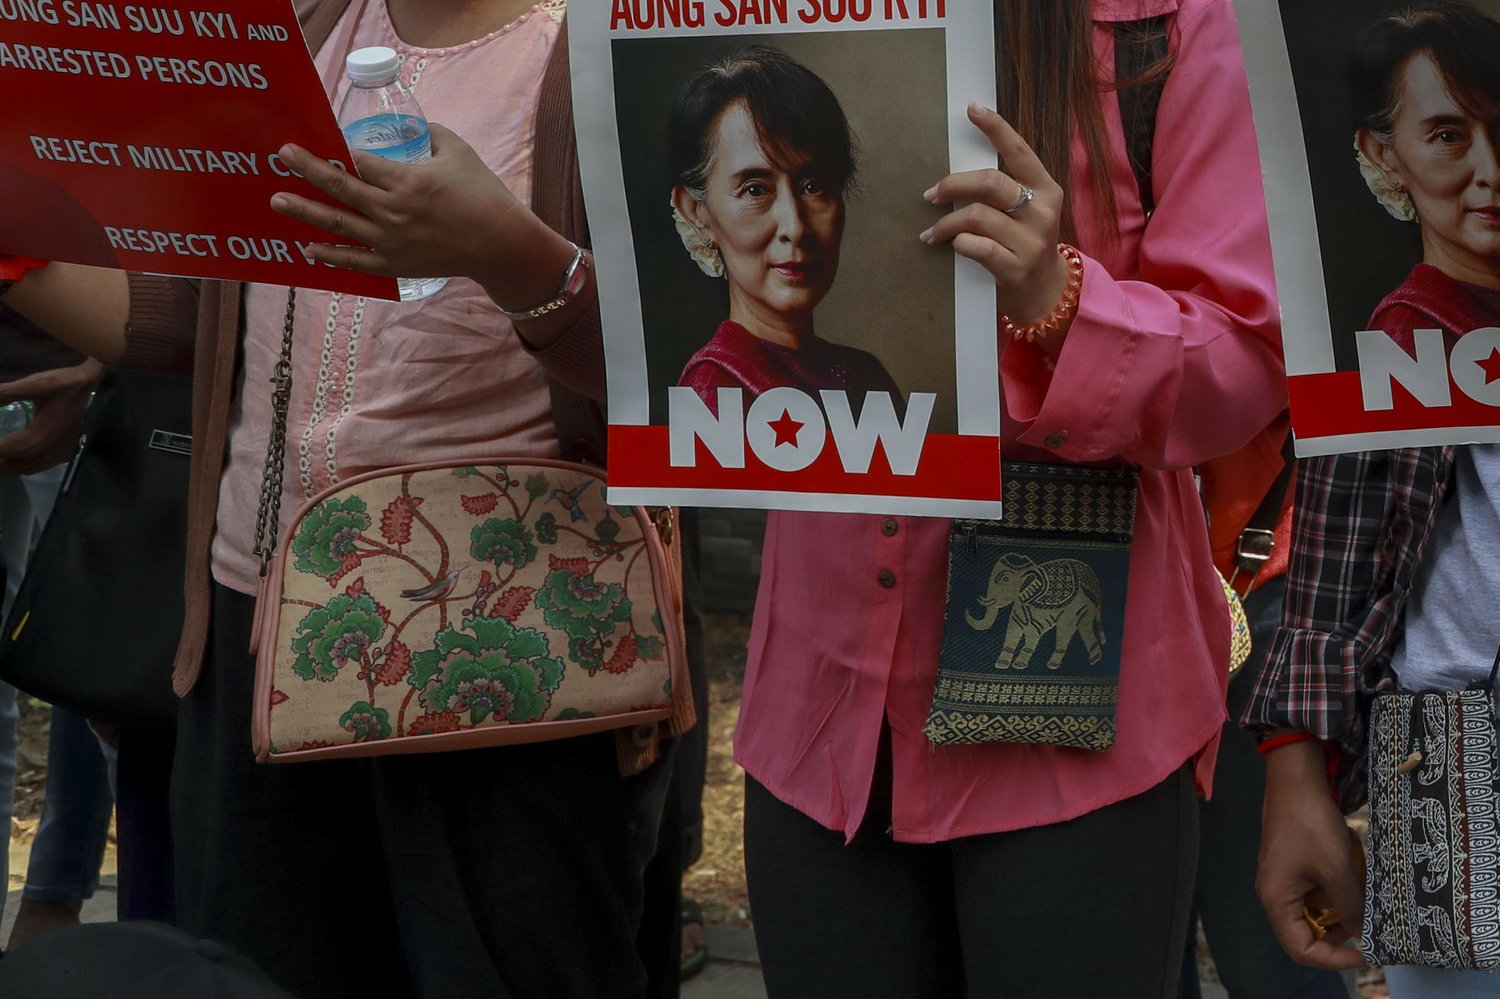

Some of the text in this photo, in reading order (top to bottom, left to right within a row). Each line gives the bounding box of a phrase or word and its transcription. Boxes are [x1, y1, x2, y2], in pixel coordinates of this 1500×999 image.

[63, 0, 121, 30] SAN
[124, 5, 184, 35] SUU
[189, 10, 239, 39] KYI
[247, 23, 288, 42] AND
[0, 42, 268, 89] ARRESTED PERSONS
[29, 135, 123, 167] REJECT
[128, 145, 260, 176] MILITARY
[104, 226, 220, 257] RESPECT
[228, 235, 294, 264] OUR
[667, 385, 937, 476] NOW
